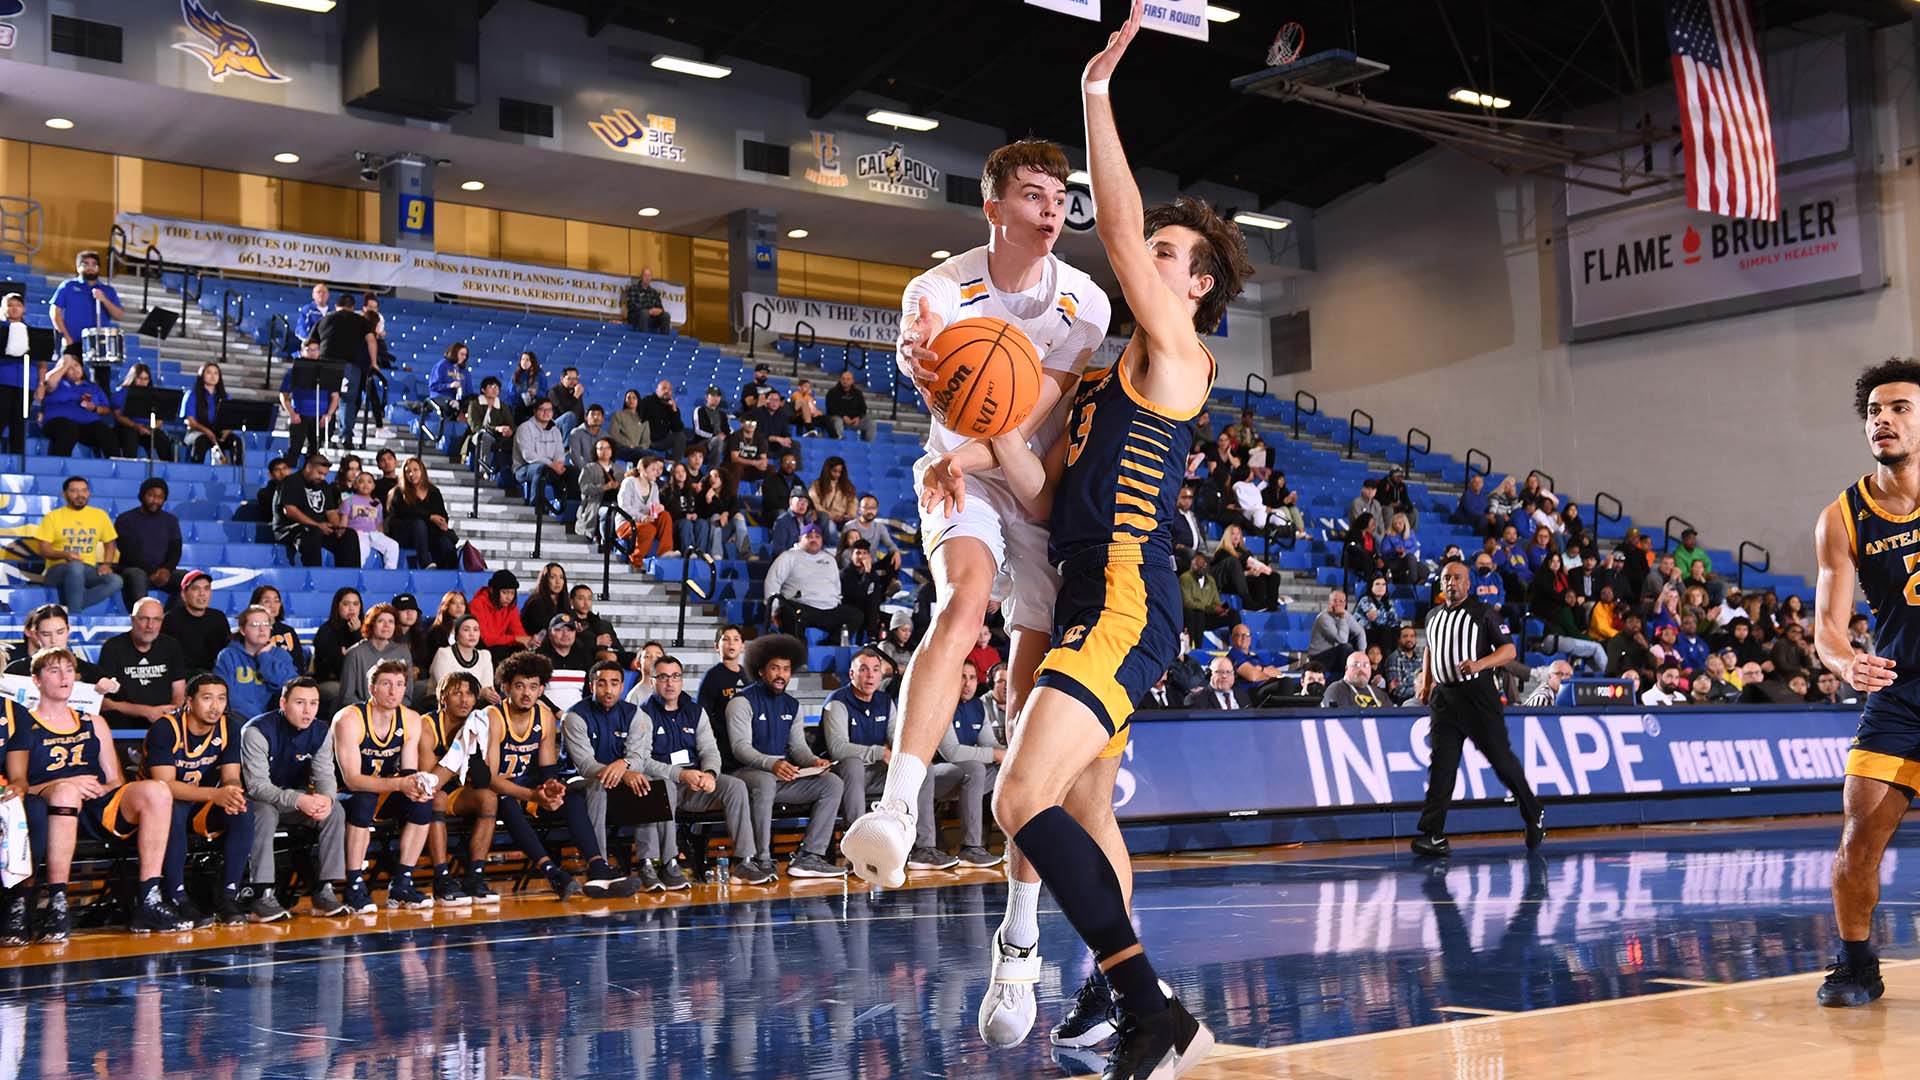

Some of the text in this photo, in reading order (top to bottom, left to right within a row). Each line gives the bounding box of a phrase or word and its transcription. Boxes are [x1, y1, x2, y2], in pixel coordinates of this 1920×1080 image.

[1143, 4, 1201, 27] FIRST ROUND
[647, 114, 676, 131] THE
[649, 129, 672, 144] BIG
[648, 144, 684, 160] WEST
[858, 156, 939, 188] CAL POLY
[406, 200, 425, 229] 9
[1070, 196, 1084, 216] A
[164, 225, 402, 264] THE LAW OFFICES OF DIXON KUMMER
[1584, 200, 1836, 284] FLAME BROILER
[237, 252, 331, 274] 661-324-2700
[1739, 242, 1838, 270] SIMPLY HEALTHY
[471, 265, 511, 280] ESTATE
[513, 270, 565, 287] PLANNING
[571, 279, 599, 292] REAL
[462, 279, 511, 294] SERVING
[513, 286, 585, 305] BAKERSFIELD
[765, 297, 800, 316] NOW
[804, 302, 822, 317] IN
[825, 303, 860, 323] THE
[849, 325, 872, 341] 661
[46, 744, 88, 771] 31
[1669, 739, 1779, 784] HEALTH
